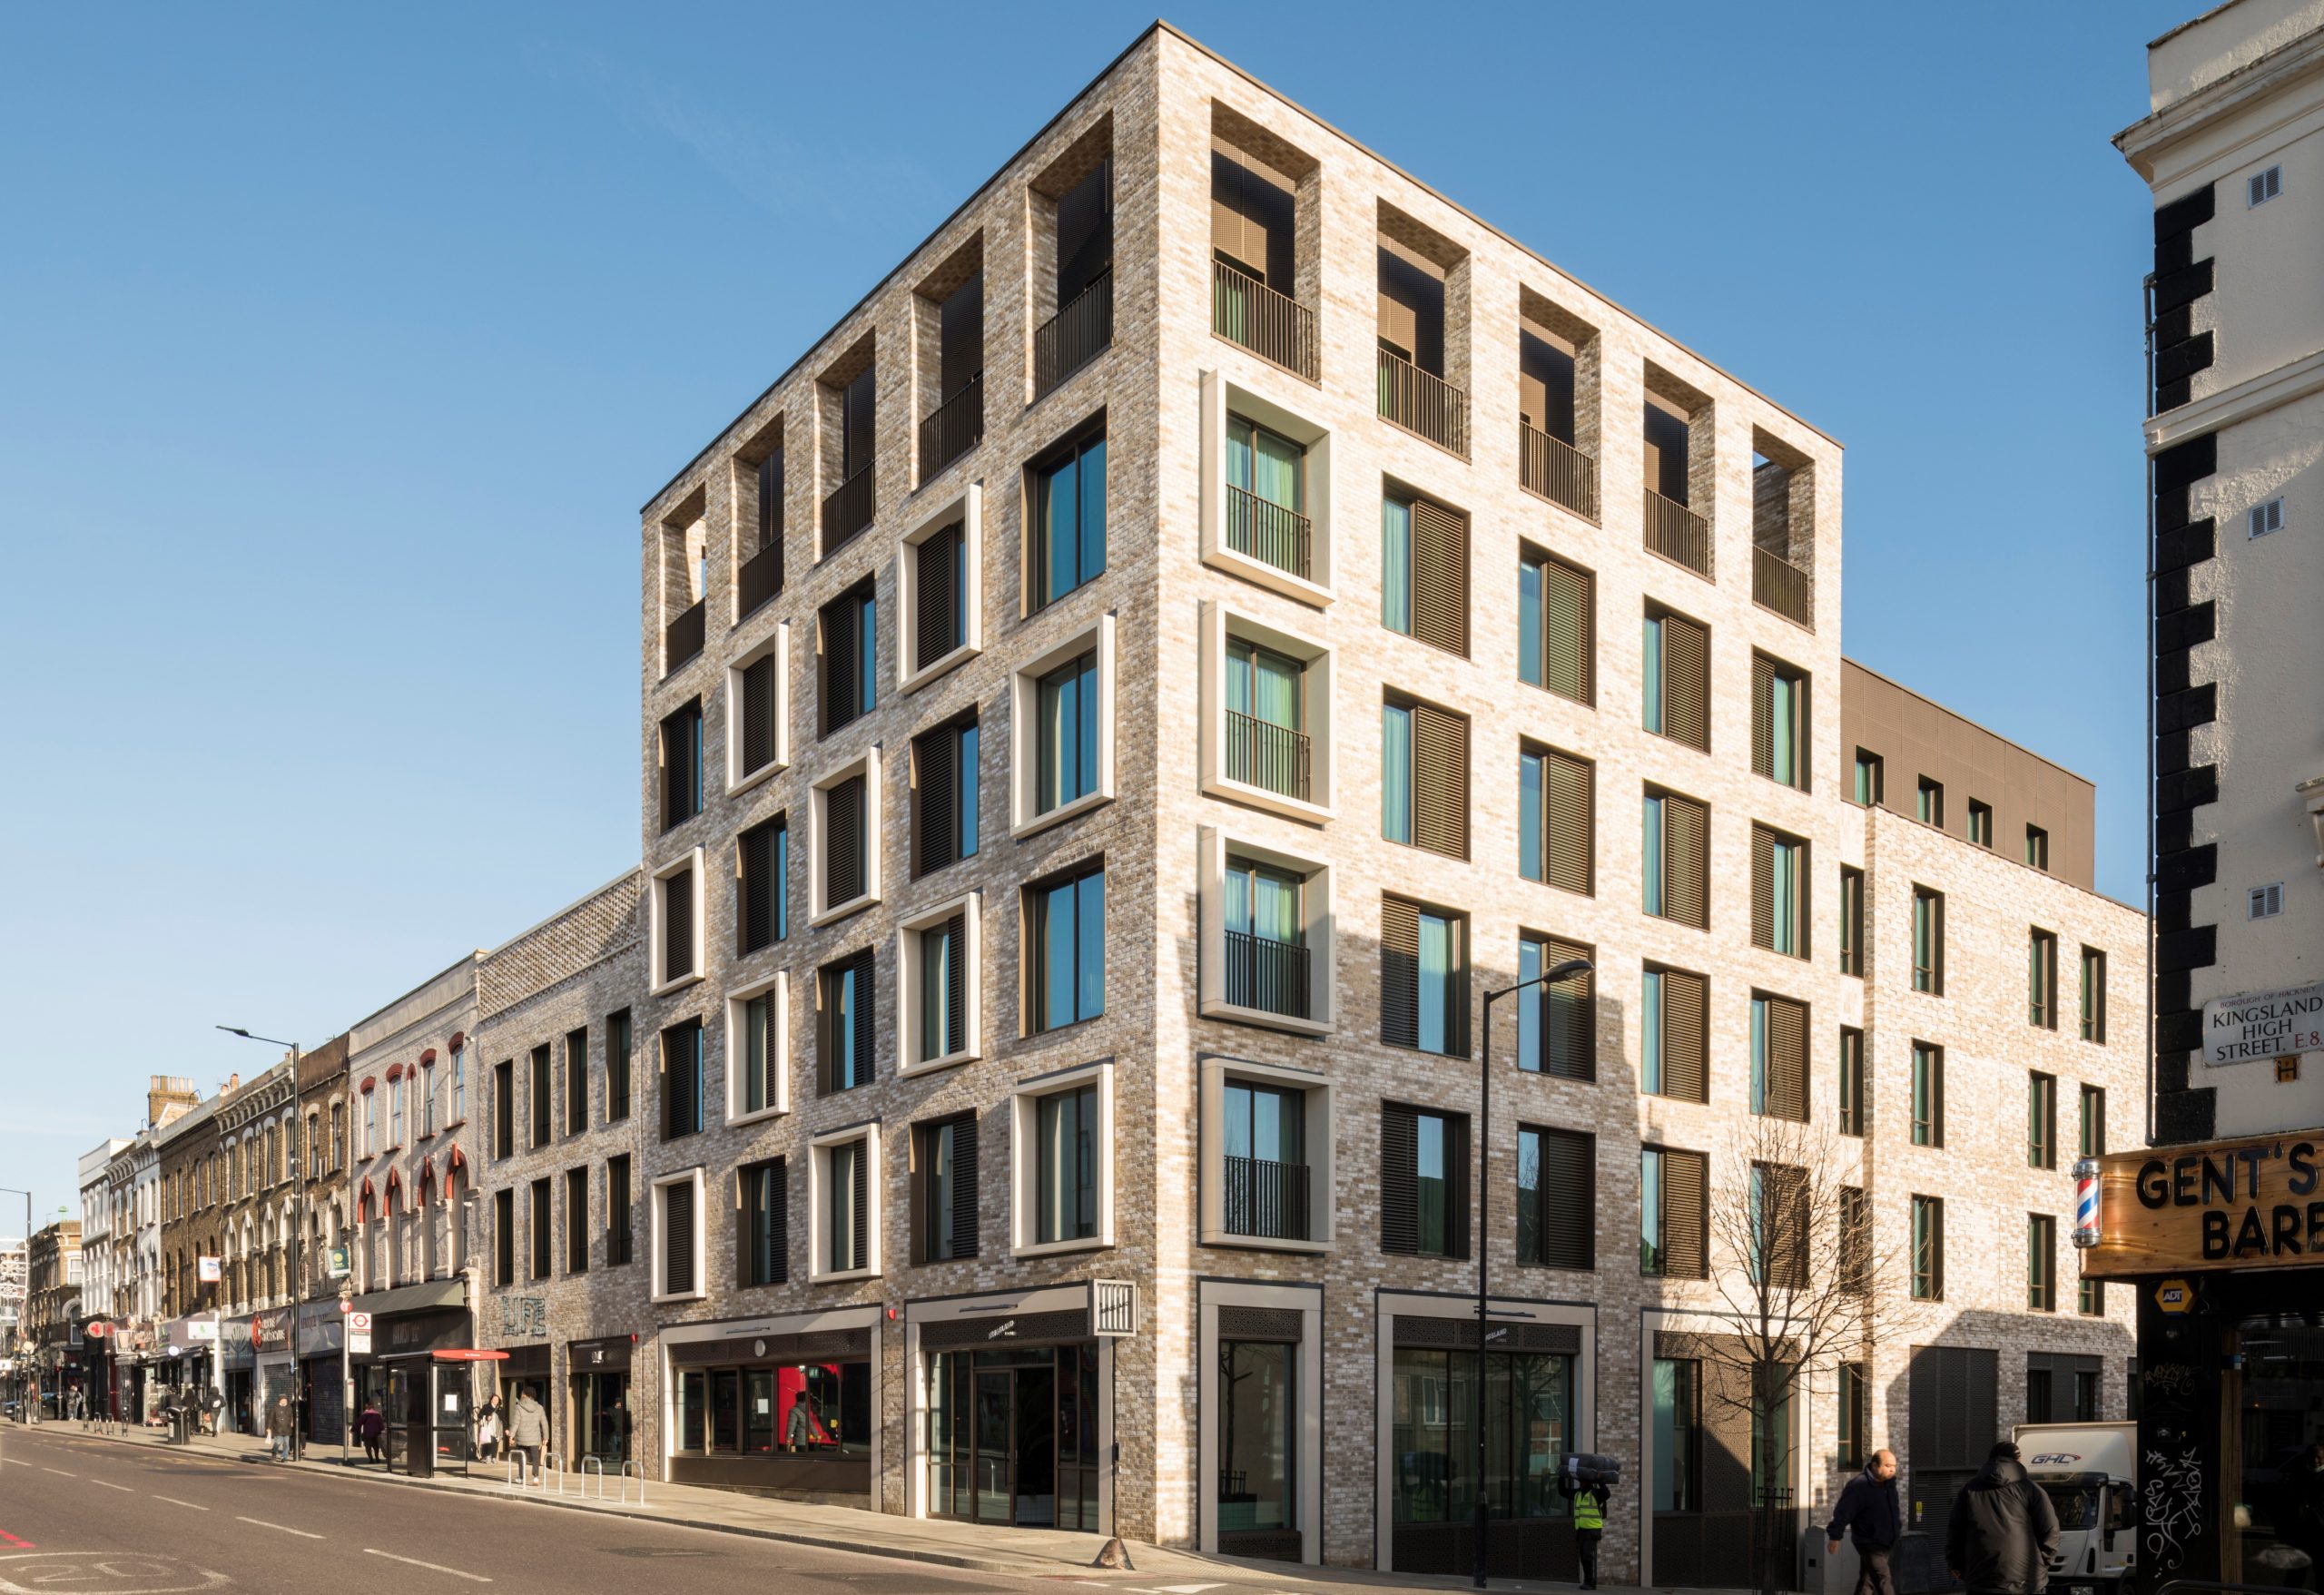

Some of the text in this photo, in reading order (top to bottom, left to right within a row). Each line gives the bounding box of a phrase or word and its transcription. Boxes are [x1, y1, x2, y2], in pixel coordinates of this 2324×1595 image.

[2220, 996, 2260, 1009] BOROUGH
[2279, 986, 2316, 998] HACKNEY
[2213, 997, 2323, 1029] KINGSLAND
[2242, 1018, 2292, 1040] HIGH
[2136, 1141, 2319, 1209] GENT'S
[2163, 1290, 2182, 1300] ADT
[2031, 1454, 2071, 1464] GHL
[15, 1561, 176, 1582] 20
